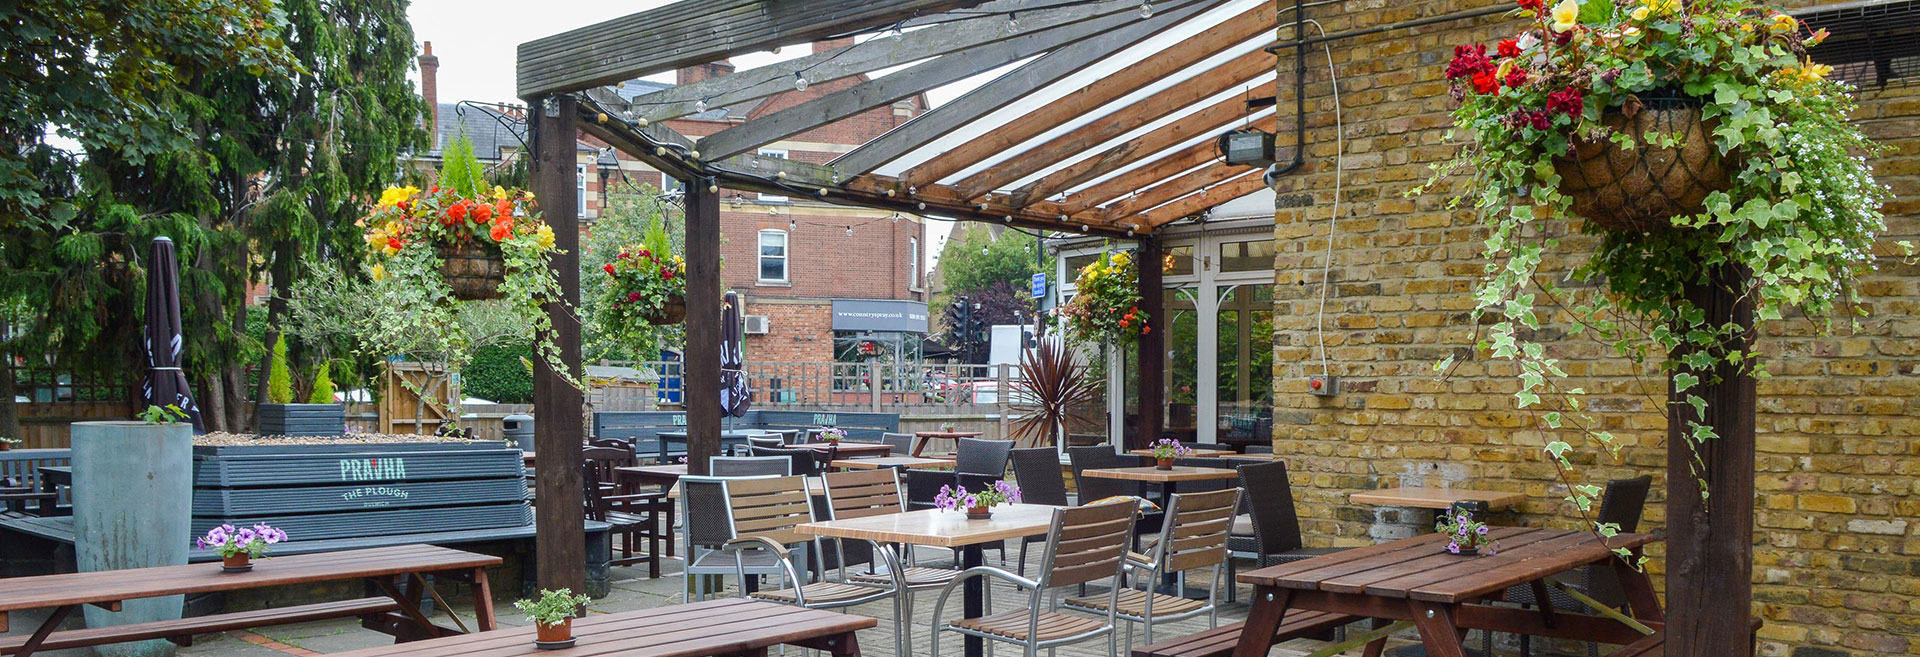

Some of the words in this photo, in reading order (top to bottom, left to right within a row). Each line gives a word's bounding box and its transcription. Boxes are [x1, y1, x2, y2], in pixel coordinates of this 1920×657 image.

[672, 414, 687, 426] PRA
[813, 413, 837, 425] PRAVHA
[340, 457, 406, 480] PRAVHA
[342, 488, 363, 501] THE
[365, 487, 409, 499] PLOUGH
